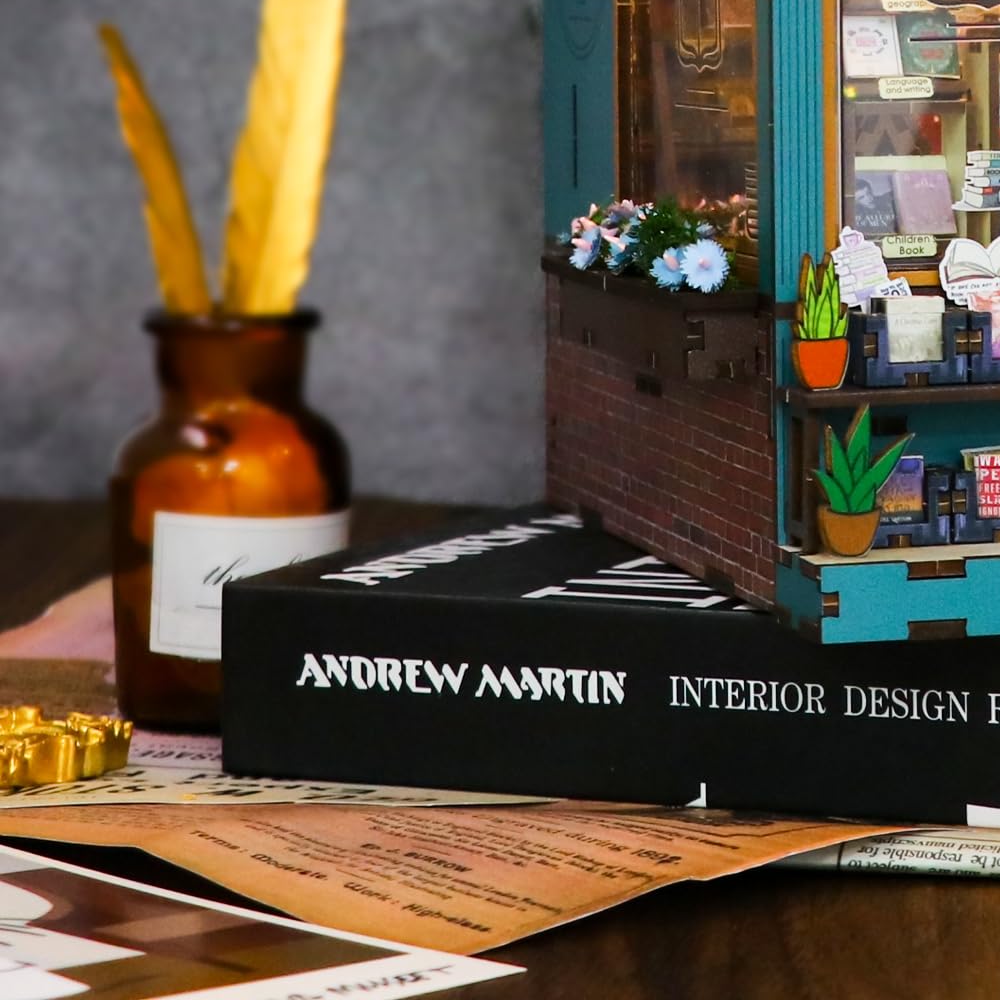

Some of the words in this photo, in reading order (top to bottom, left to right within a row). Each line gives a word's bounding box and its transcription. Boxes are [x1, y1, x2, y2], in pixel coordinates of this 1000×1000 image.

[899, 246, 924, 255] Book
[296, 653, 468, 694] ANDREW
[475, 664, 626, 705] MARTIN
[669, 675, 826, 714] INTERIOR
[844, 685, 970, 723] DESIGN
[857, 845, 881, 857] for
[883, 847, 963, 862] responsible
[970, 853, 987, 868] be
